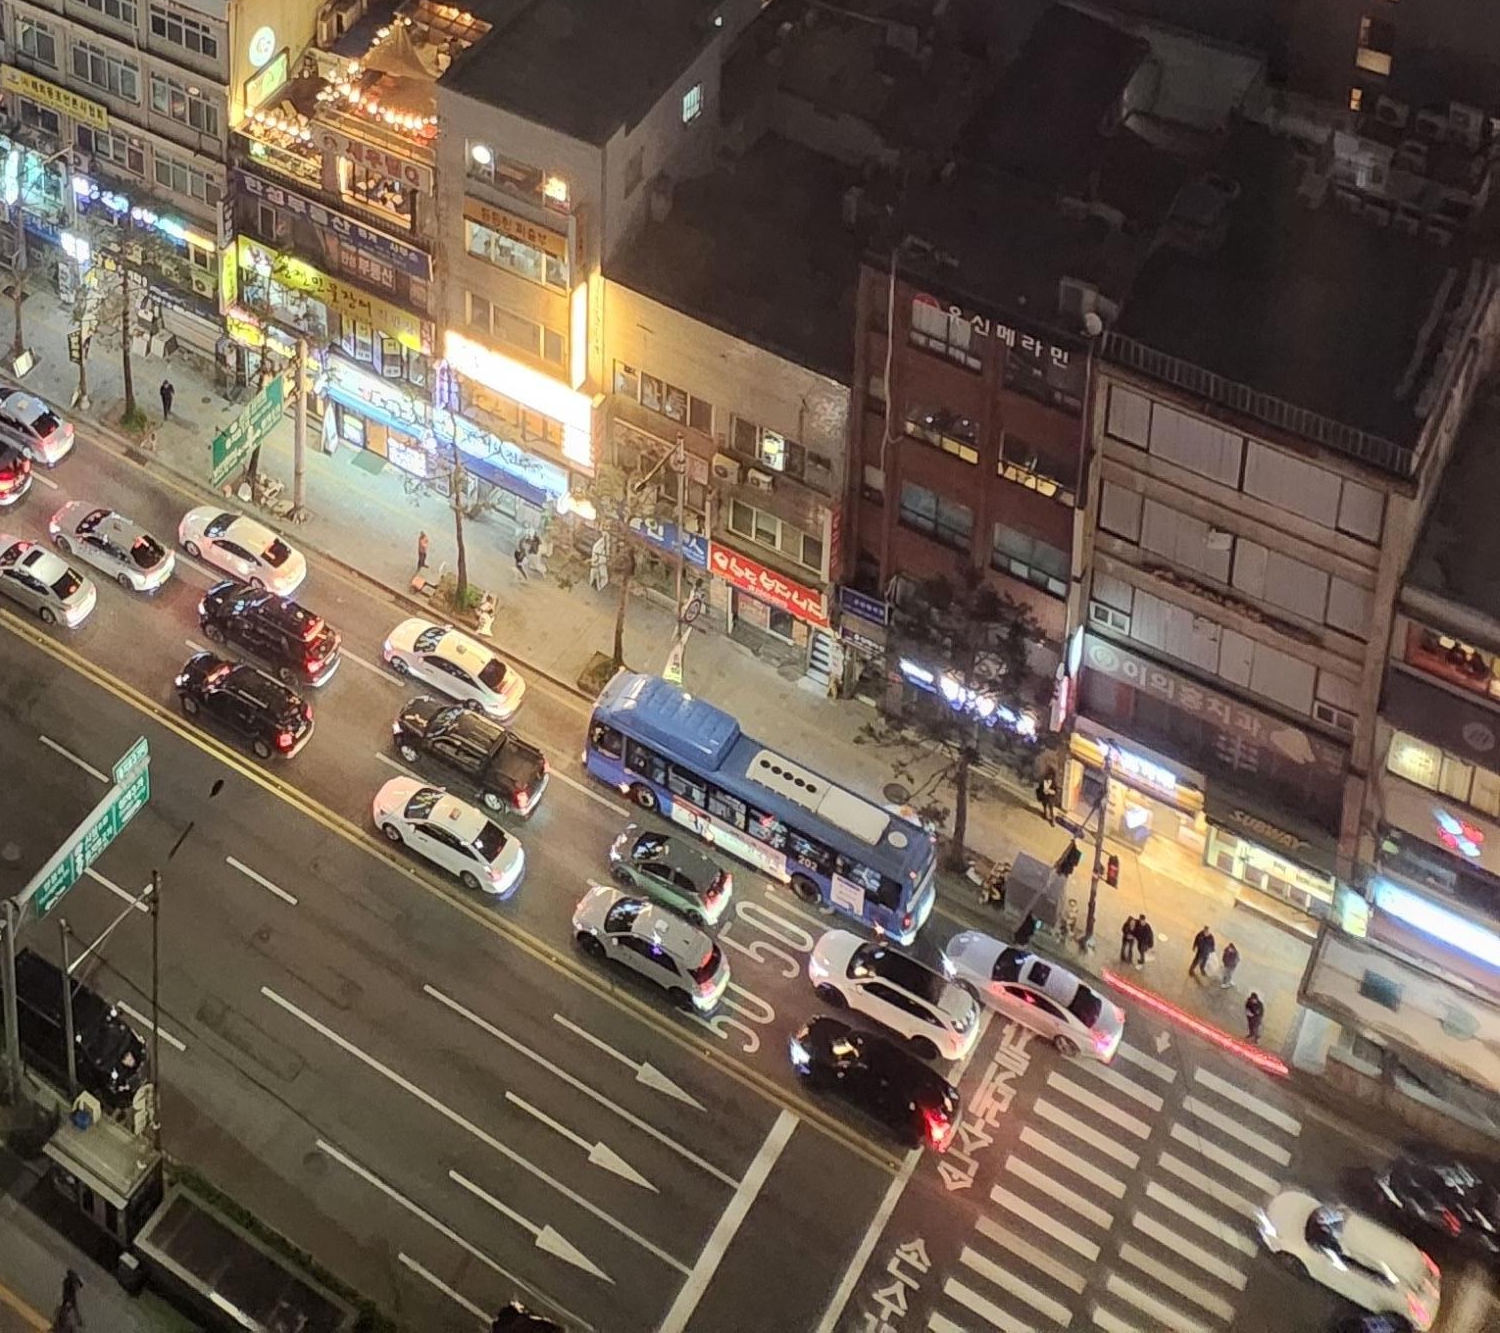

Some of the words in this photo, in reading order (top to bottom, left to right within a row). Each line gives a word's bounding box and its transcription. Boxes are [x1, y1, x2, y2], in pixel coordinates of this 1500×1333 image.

[949, 305, 1069, 369] 유신메라민
[1228, 810, 1312, 850] SUBWAY
[798, 855, 818, 872] 202
[718, 900, 814, 979] 50
